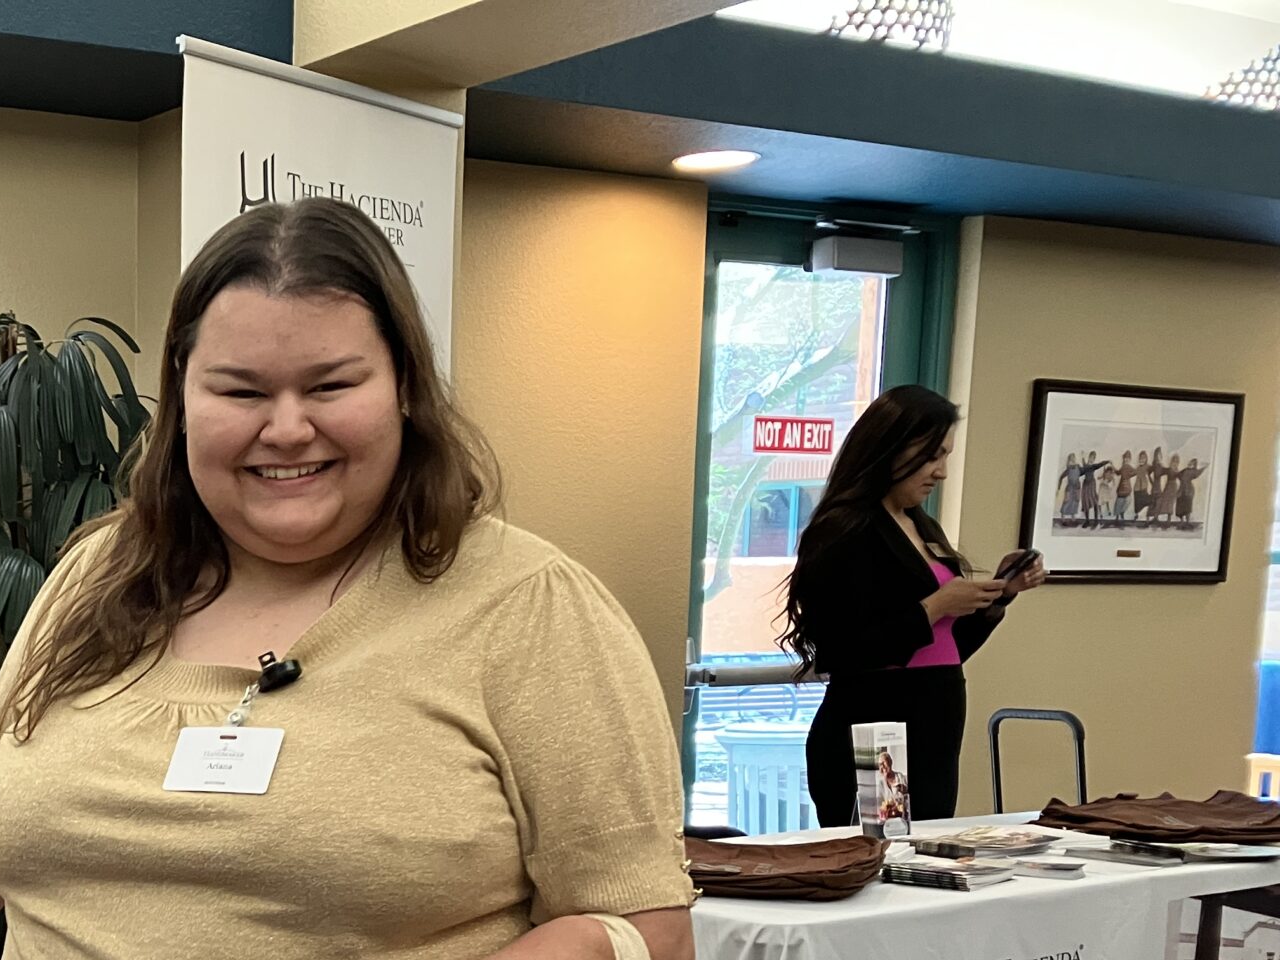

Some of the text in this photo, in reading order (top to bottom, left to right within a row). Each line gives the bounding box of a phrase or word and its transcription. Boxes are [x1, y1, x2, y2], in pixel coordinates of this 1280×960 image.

[329, 181, 423, 228] HACIENDA
[755, 421, 832, 450] NOT AN EXIT
